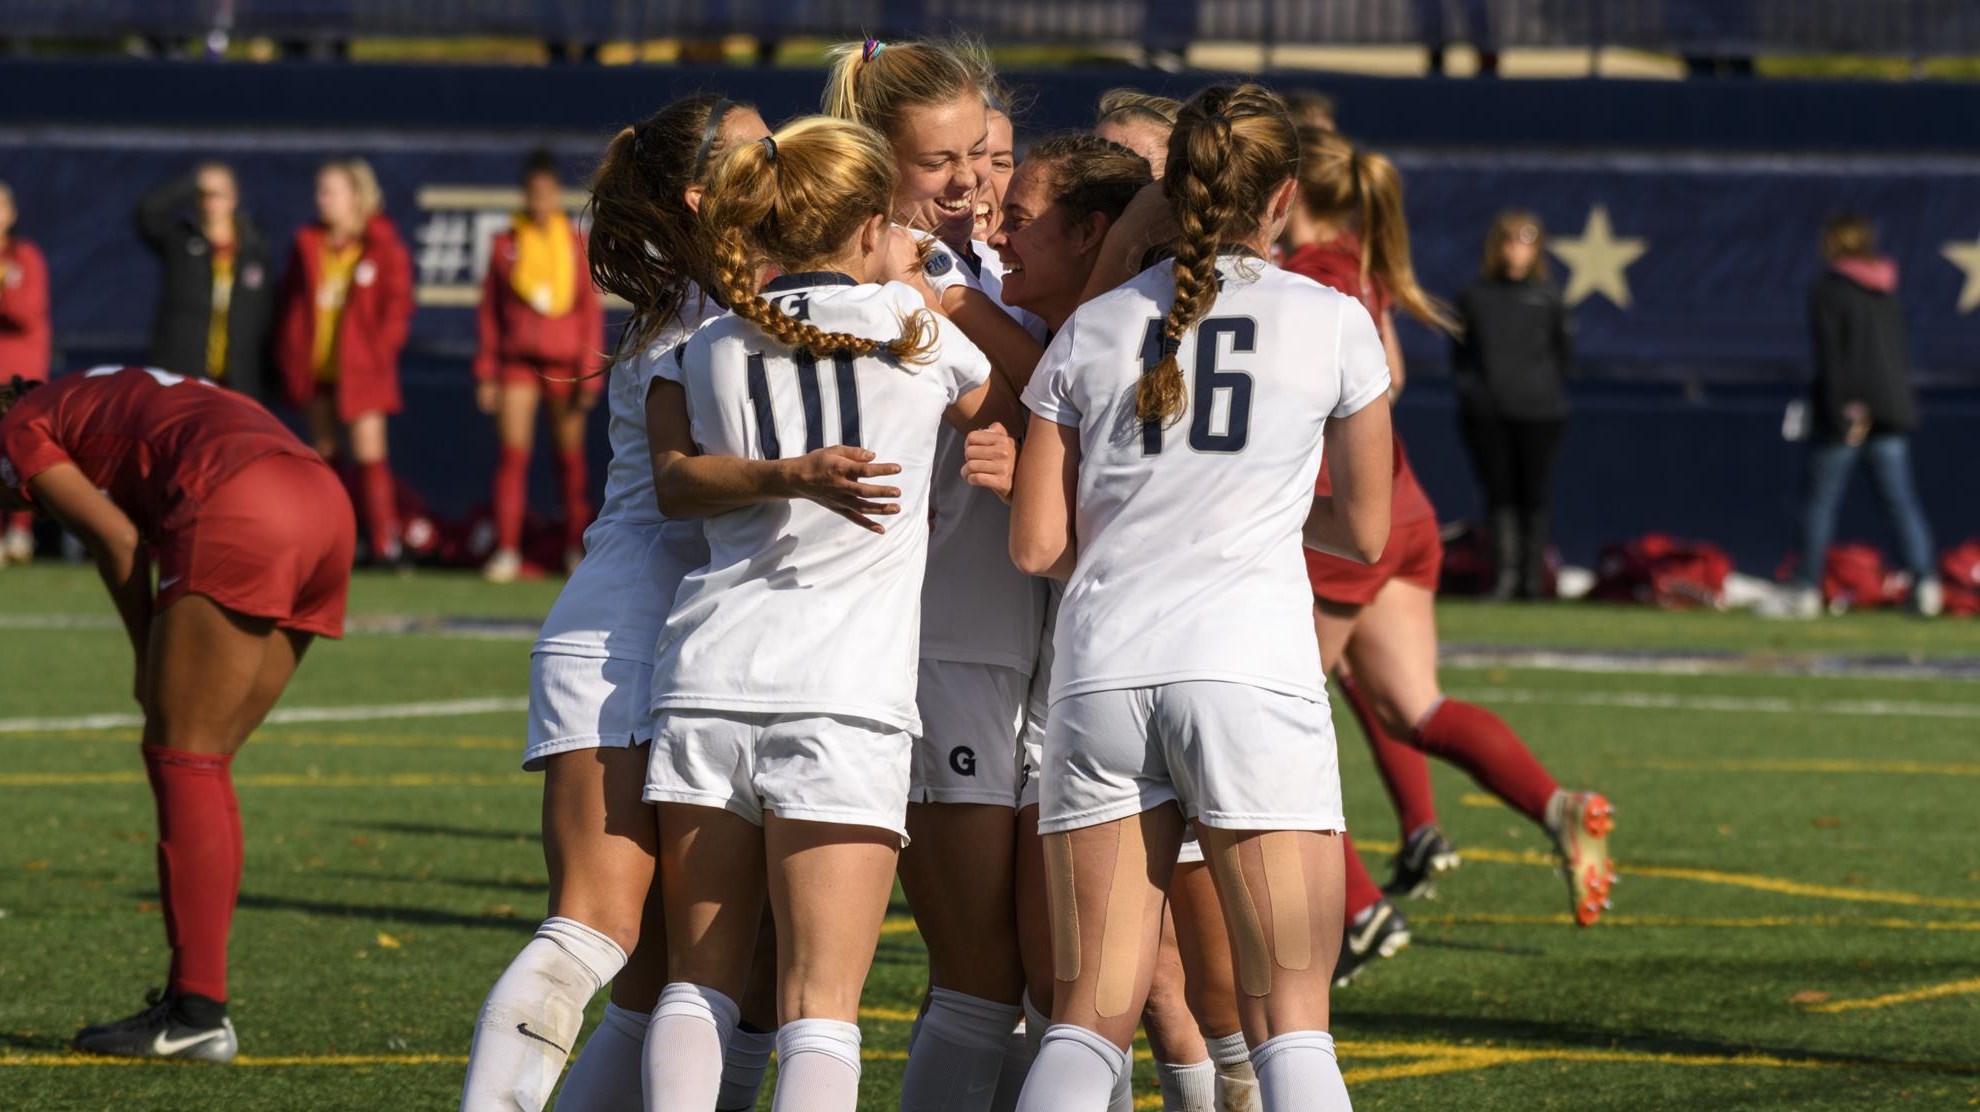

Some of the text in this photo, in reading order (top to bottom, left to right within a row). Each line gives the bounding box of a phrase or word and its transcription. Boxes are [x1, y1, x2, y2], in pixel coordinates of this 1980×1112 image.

[769, 291, 811, 321] G
[1136, 315, 1258, 458] 16
[950, 745, 977, 777] G
